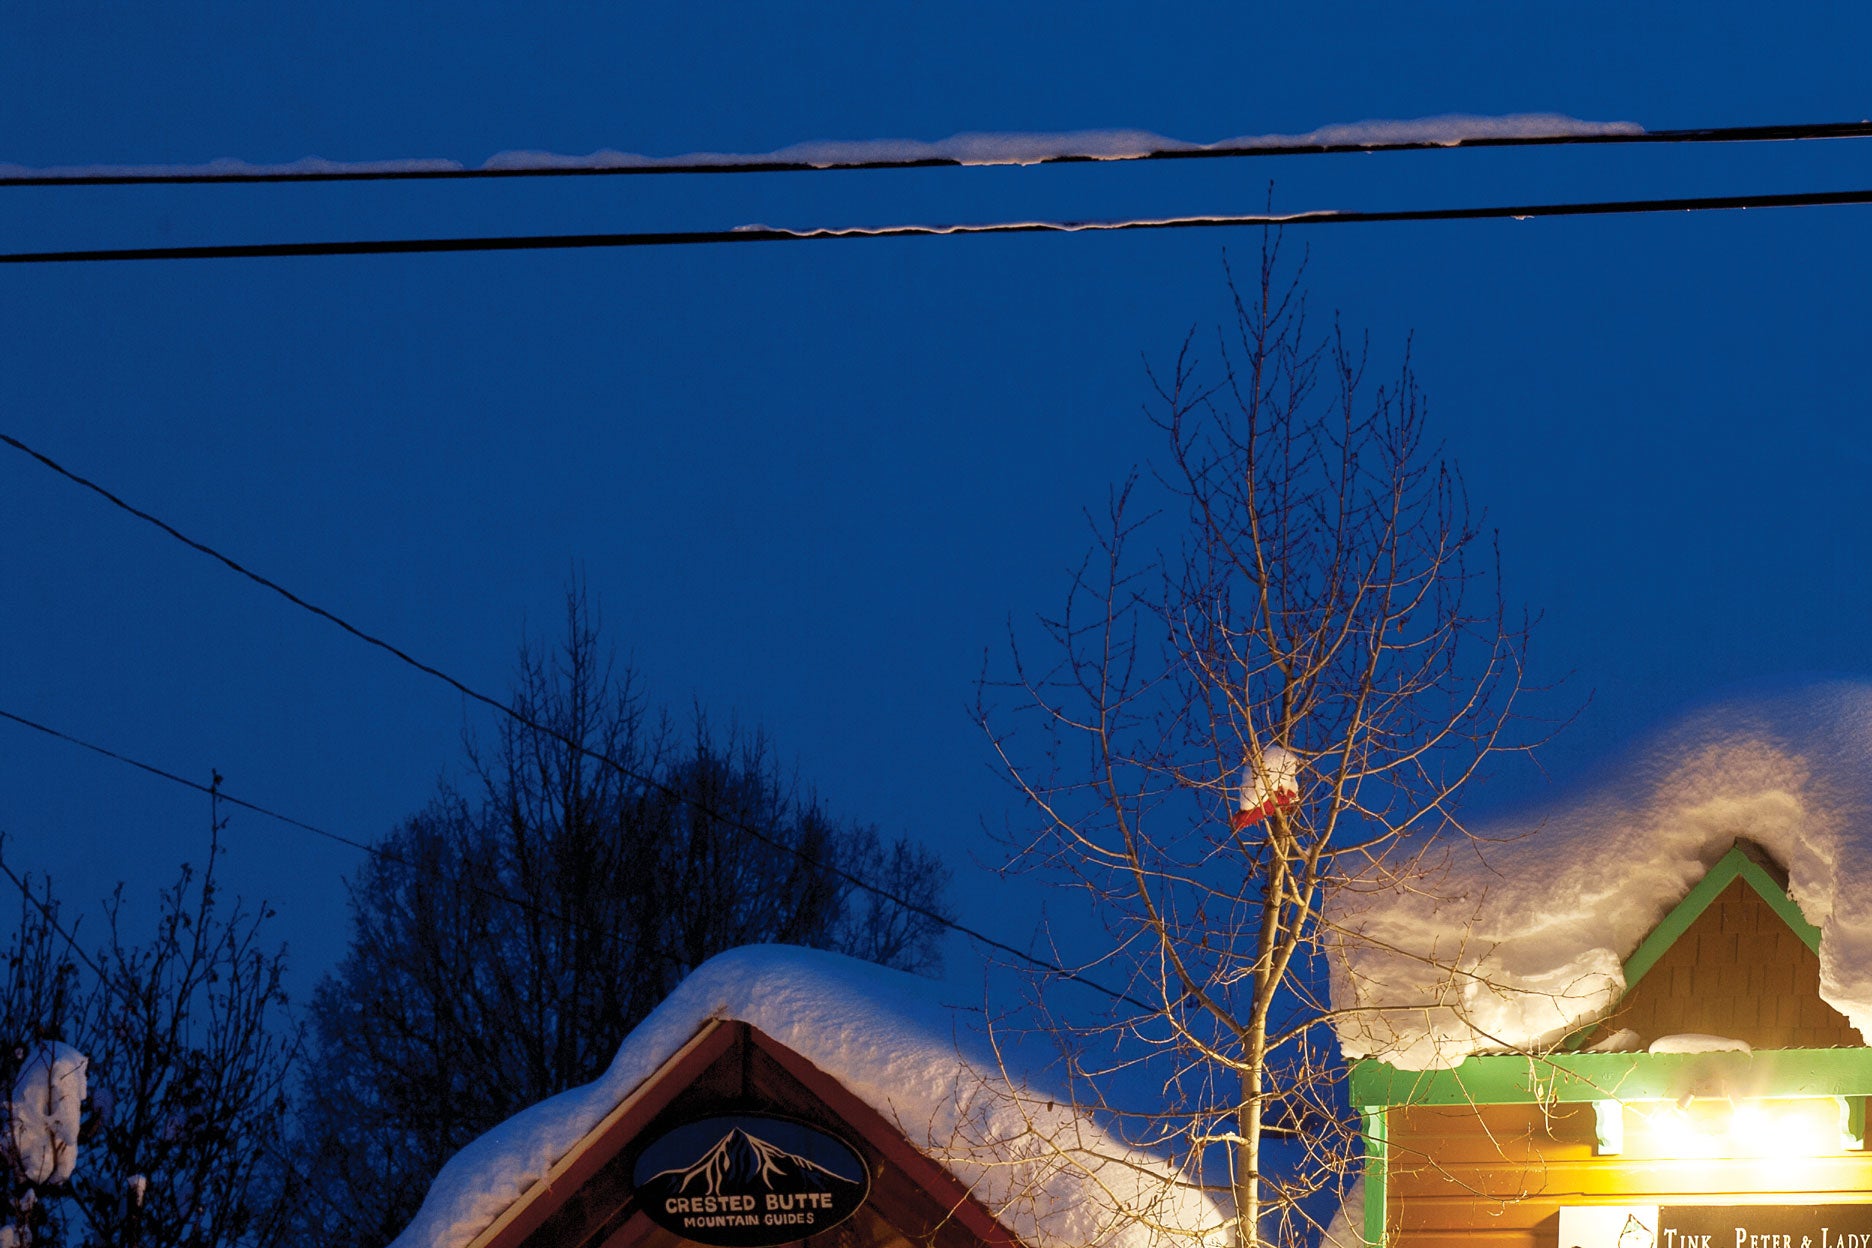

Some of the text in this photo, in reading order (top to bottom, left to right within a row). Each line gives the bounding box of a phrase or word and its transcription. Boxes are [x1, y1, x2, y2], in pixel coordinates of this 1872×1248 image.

[665, 1192, 833, 1214] CRESTED BUTTE
[683, 1212, 815, 1228] MOUNTAIN GUIDES
